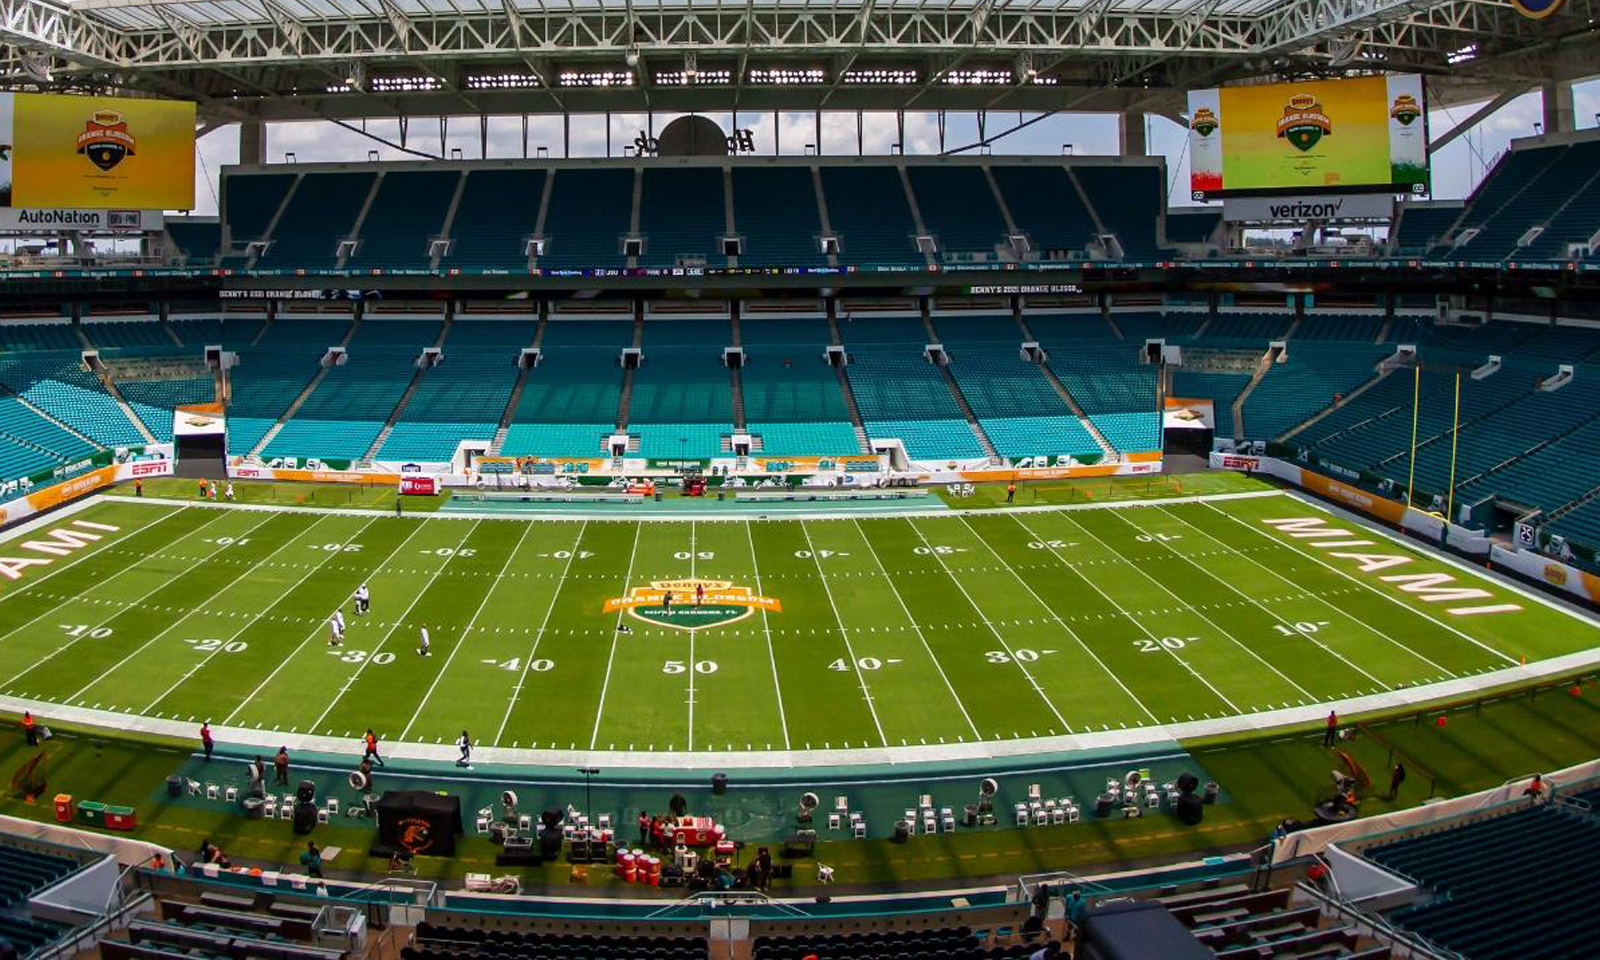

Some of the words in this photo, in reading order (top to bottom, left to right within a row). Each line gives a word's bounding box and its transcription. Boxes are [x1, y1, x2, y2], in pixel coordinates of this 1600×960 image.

[19, 210, 100, 223] AutoNation
[1270, 201, 1335, 218] verizon
[132, 462, 167, 476] ESPN
[1223, 456, 1259, 470] ESPN
[1521, 526, 1532, 542] 25
[1262, 518, 1523, 615] MIAMI
[66, 624, 113, 638] 10
[1273, 622, 1319, 637] 10
[193, 639, 247, 653] 20
[1133, 637, 1185, 652] 20
[340, 650, 396, 664] 30
[984, 649, 1038, 663] 30
[497, 657, 555, 671] 40
[662, 660, 718, 674] 50
[827, 657, 881, 671] 40
